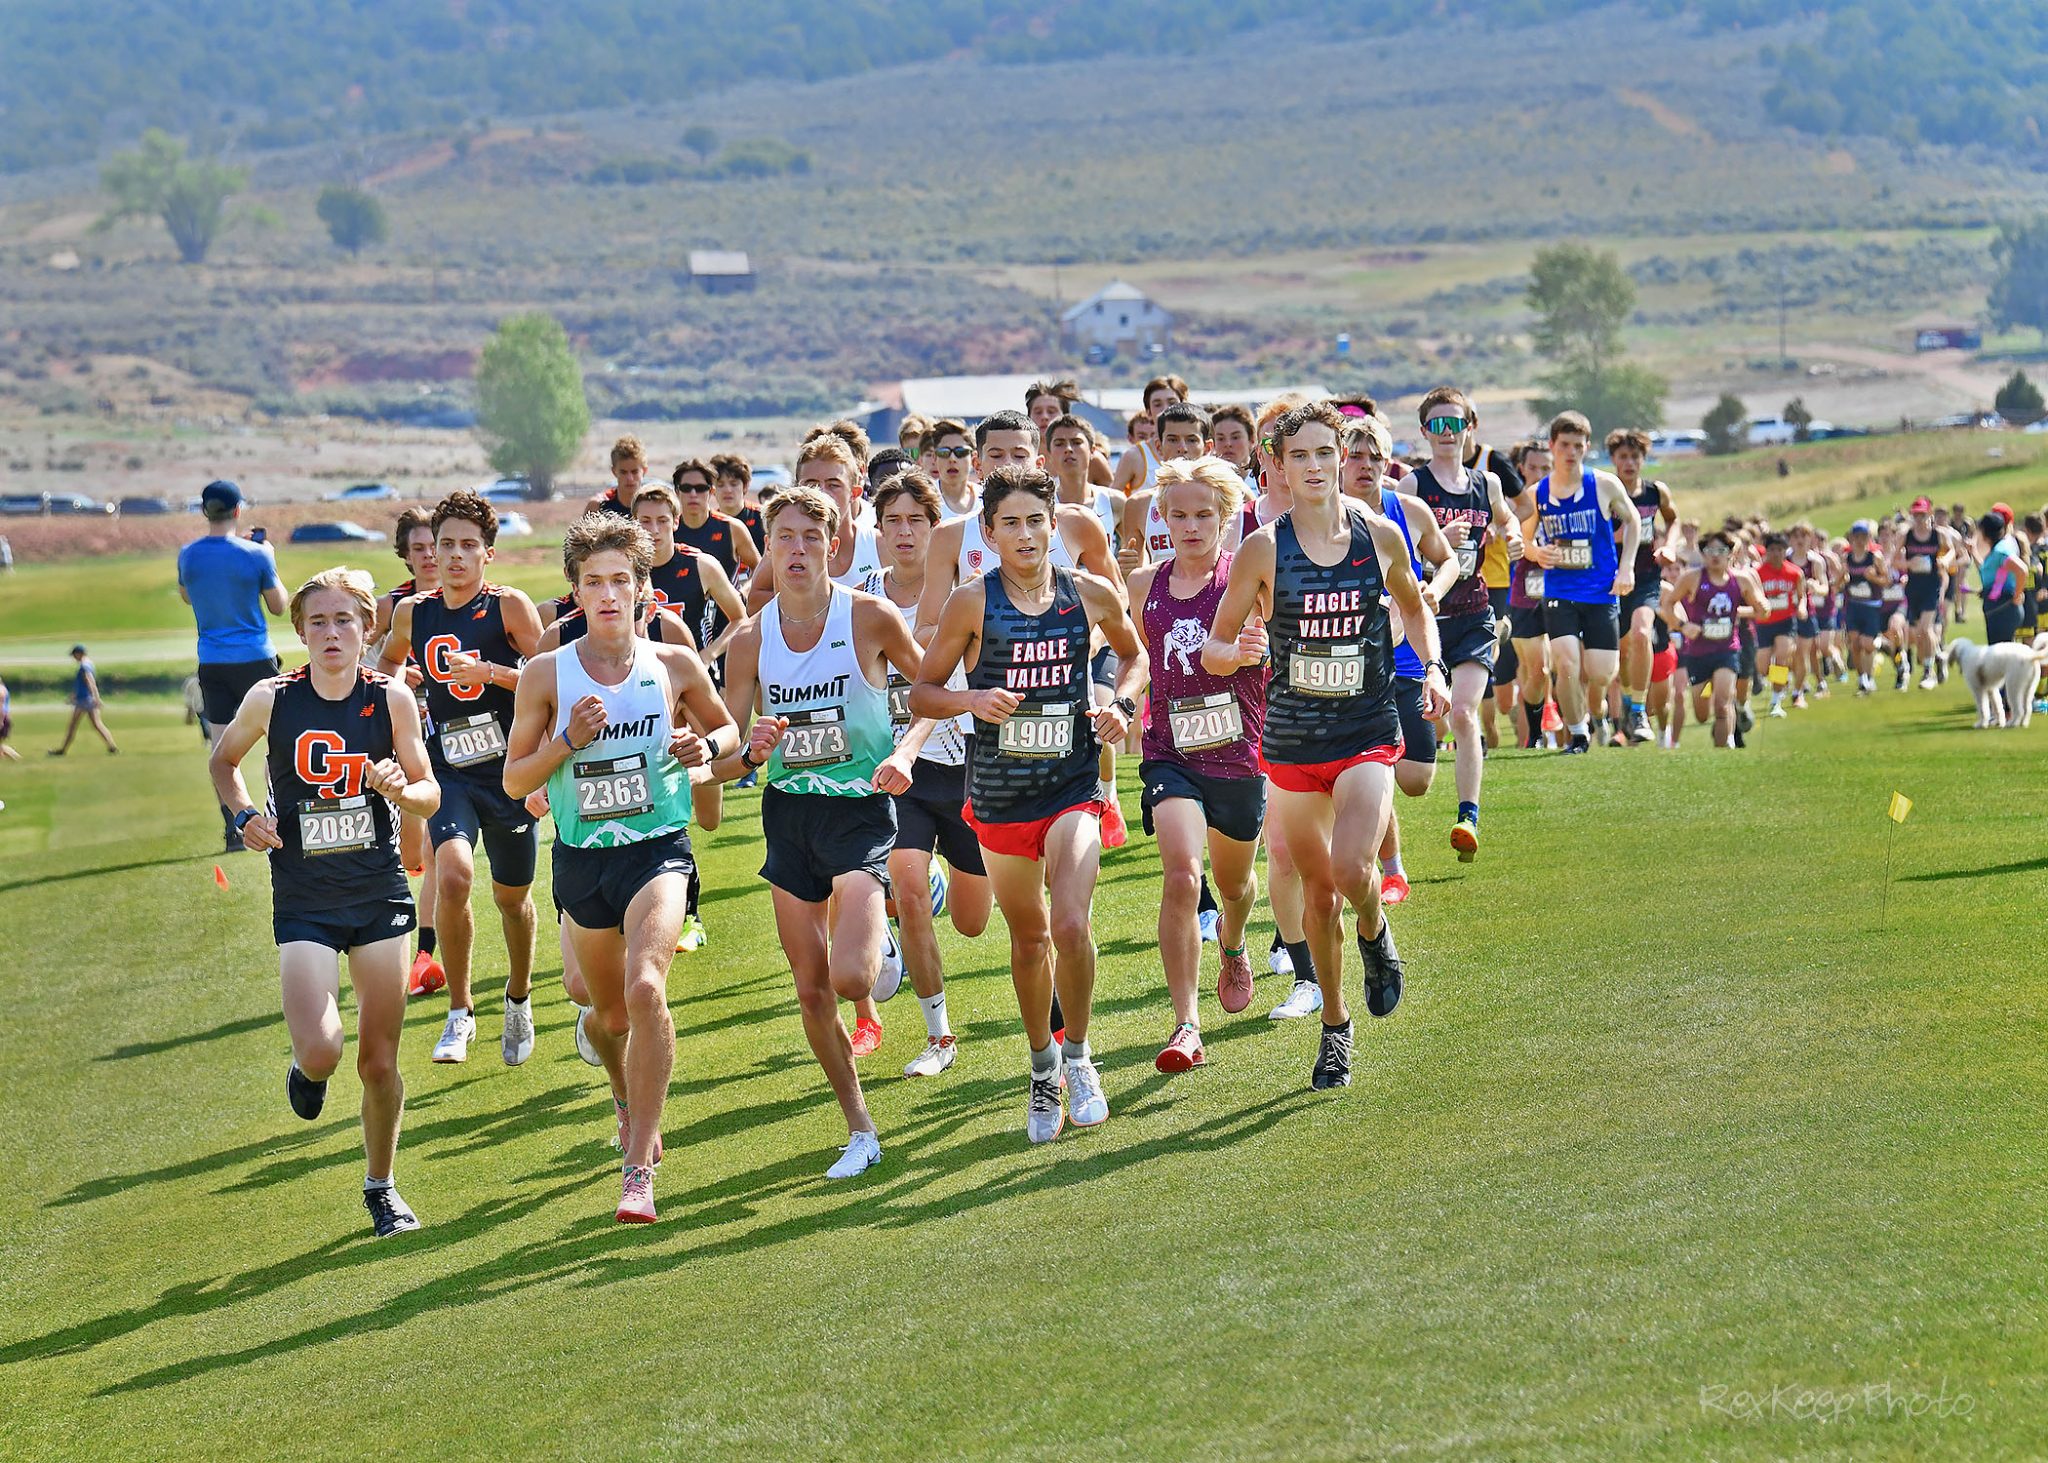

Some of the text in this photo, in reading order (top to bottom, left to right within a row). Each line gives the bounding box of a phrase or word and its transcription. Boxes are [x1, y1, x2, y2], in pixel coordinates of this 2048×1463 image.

[1569, 509, 1597, 534] COUNTY
[1556, 548, 1590, 564] 169
[1304, 590, 1360, 614] EAGLE
[1298, 615, 1365, 638] VALLEY
[1012, 638, 1069, 663] EAGLE
[1006, 663, 1073, 689] VALLEY
[1295, 660, 1360, 687] 1909
[769, 674, 850, 705] SUMMIT
[1004, 720, 1069, 748] 1908
[1175, 708, 1237, 742] 2201
[444, 726, 502, 760] 2081
[782, 726, 845, 758] 2373
[580, 773, 648, 810] 2363
[303, 811, 373, 845] 2082
